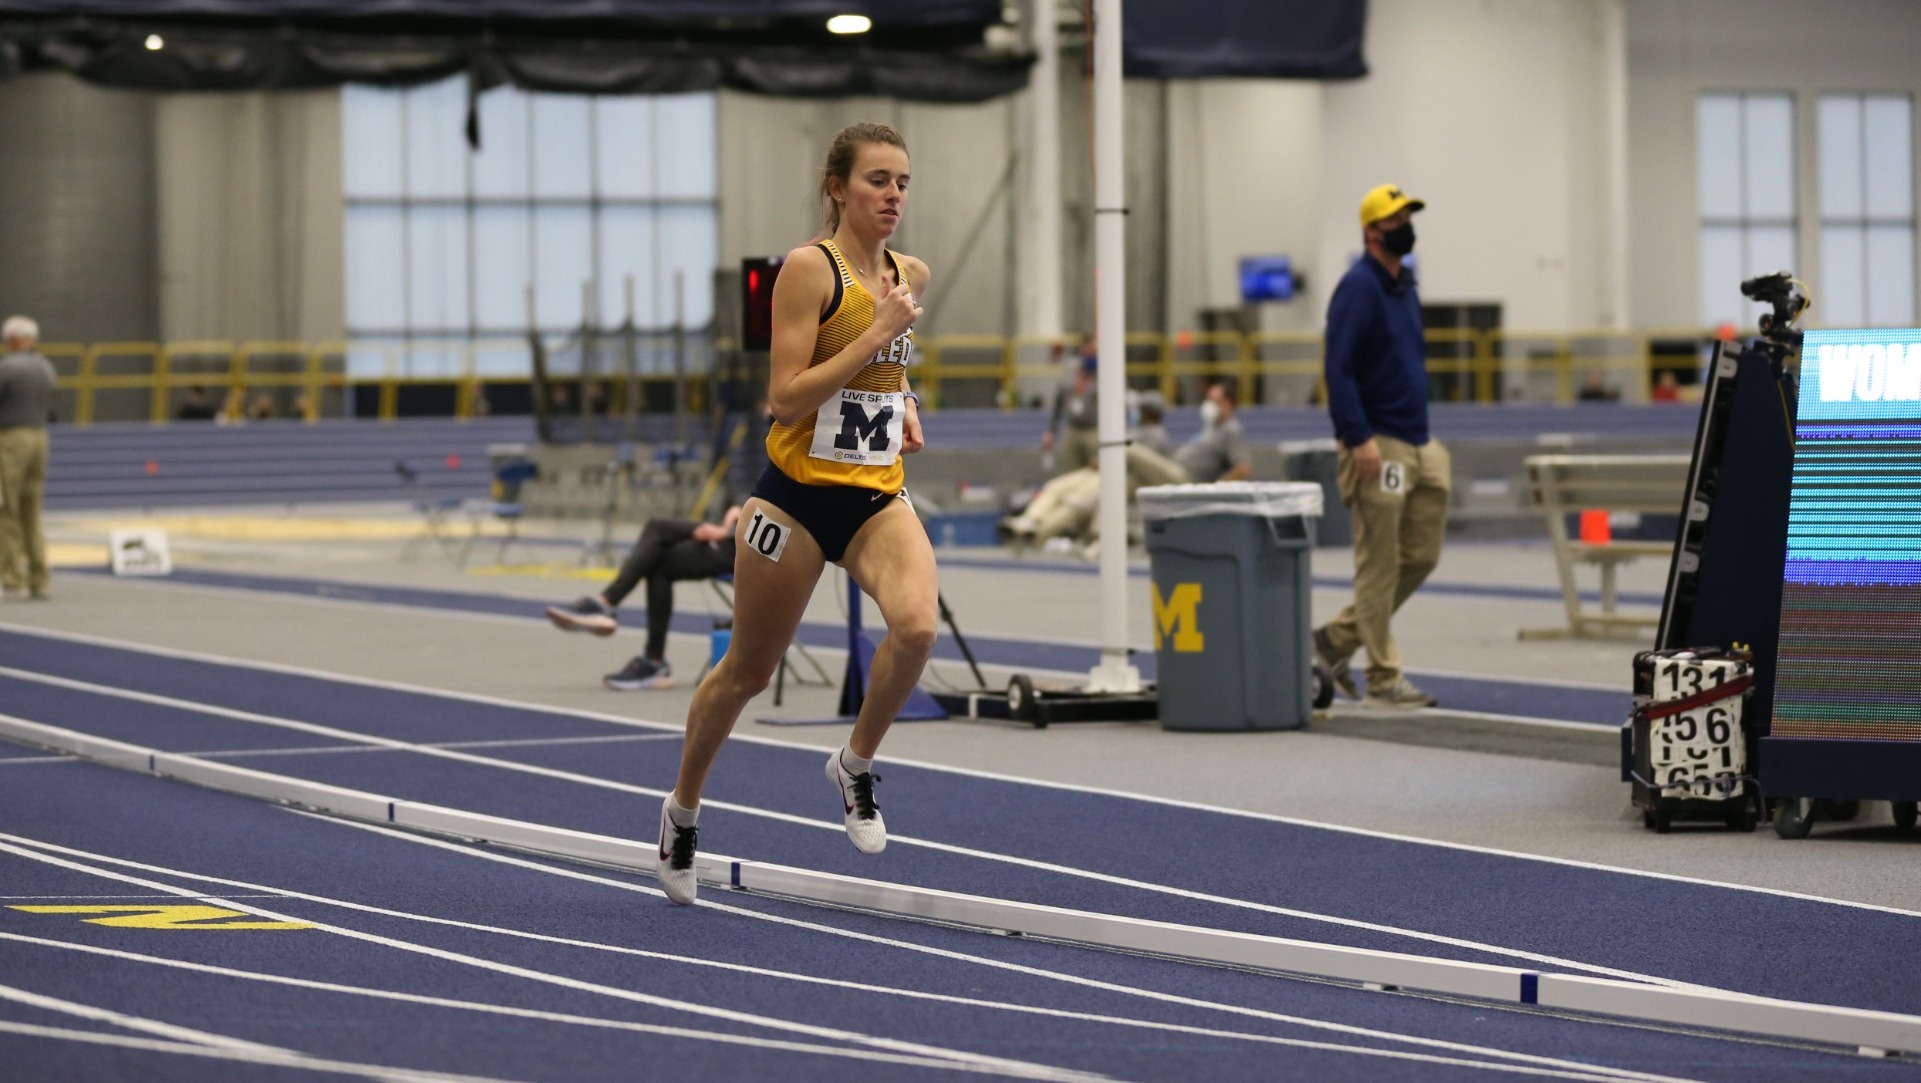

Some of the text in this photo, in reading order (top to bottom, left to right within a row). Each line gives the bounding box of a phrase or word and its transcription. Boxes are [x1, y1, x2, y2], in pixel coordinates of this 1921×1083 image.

[841, 390, 866, 401] LIVE
[833, 400, 894, 451] M
[1385, 463, 1400, 489] 6
[748, 513, 781, 555] 10
[1151, 582, 1204, 652] M
